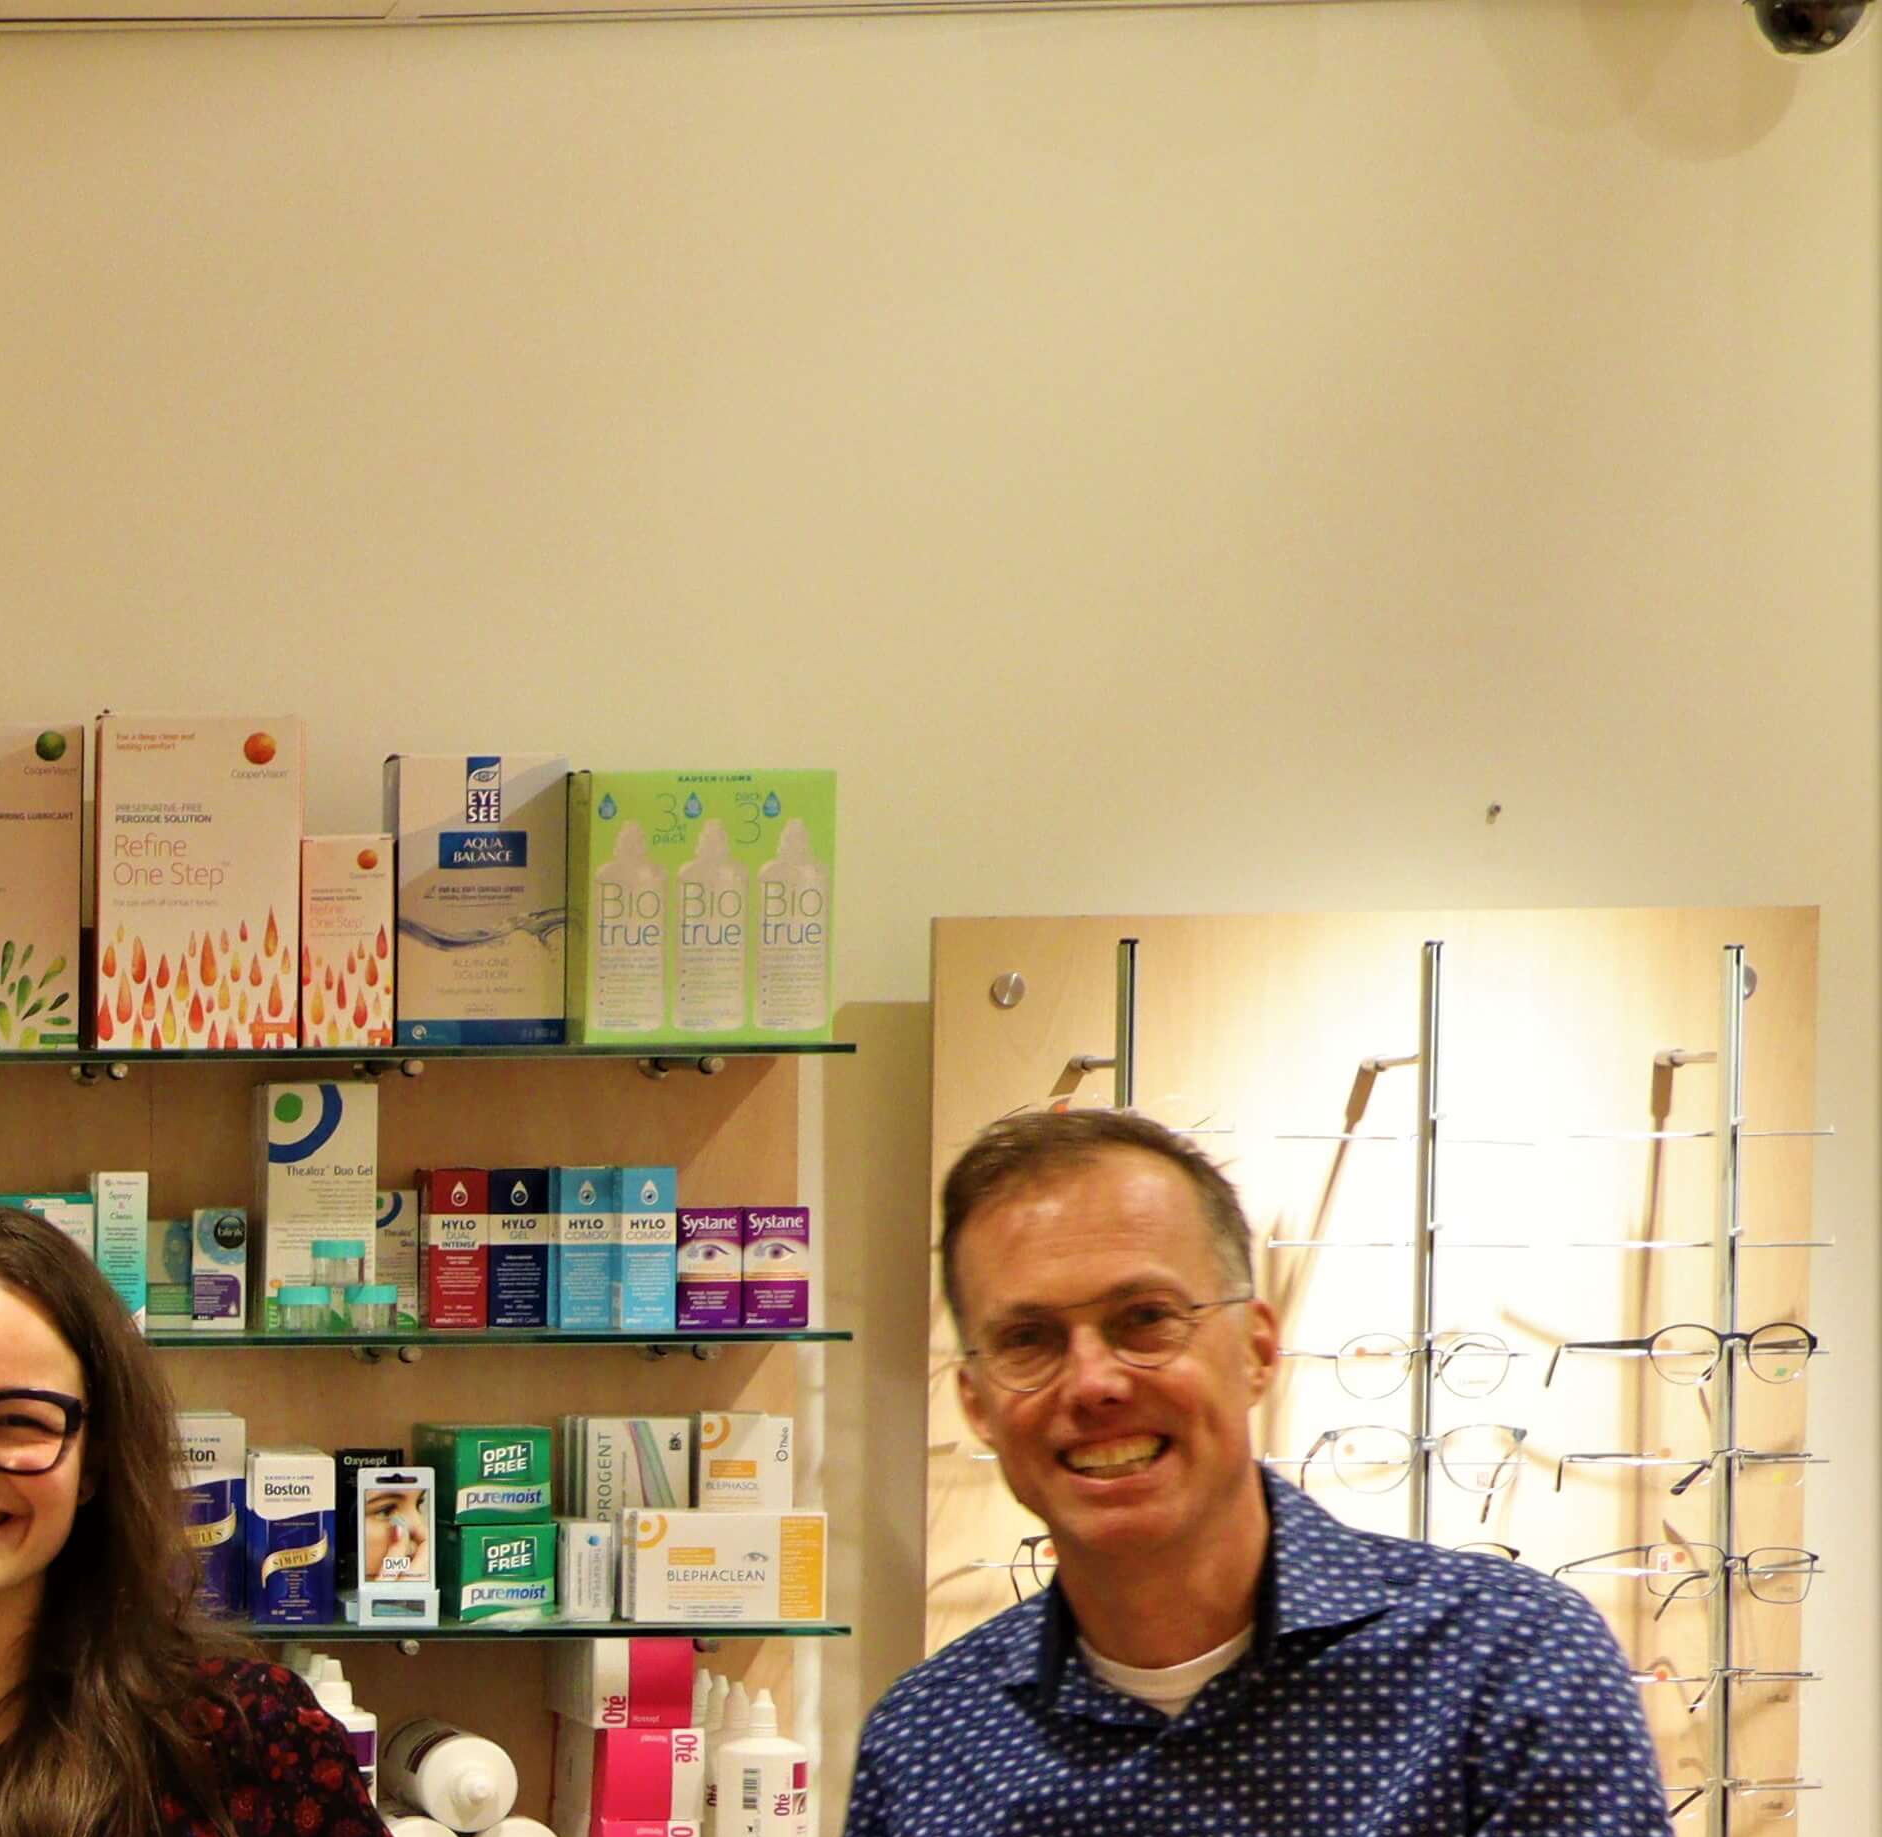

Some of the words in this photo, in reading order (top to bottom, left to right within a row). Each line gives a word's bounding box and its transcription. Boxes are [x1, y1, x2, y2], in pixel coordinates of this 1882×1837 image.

[468, 790, 499, 806] EYE
[116, 815, 162, 824] PEROXIDE
[164, 814, 211, 823] SOLUTION
[468, 806, 499, 822] SEE
[736, 802, 761, 844] 3
[115, 833, 187, 858] Refine
[463, 838, 503, 849] AQUA
[653, 833, 685, 845] pack
[453, 851, 512, 863] BALANCE
[113, 862, 163, 886] One
[172, 862, 224, 890] Step
[600, 882, 661, 919] Bio
[682, 882, 741, 918] Bio
[764, 881, 823, 918] Bio
[598, 919, 660, 947] true
[681, 918, 741, 946] true
[763, 917, 822, 946] true
[287, 1166, 325, 1177] Thealoz
[334, 1166, 354, 1176] Duo
[357, 1165, 373, 1176] Gel
[442, 1220, 476, 1230] HYLO
[502, 1219, 537, 1229] HYLO
[569, 1219, 604, 1229] HYLO
[630, 1218, 665, 1229] HYLO
[683, 1214, 737, 1237] Systane
[748, 1213, 804, 1236] Systane
[509, 1231, 529, 1239] GEL
[343, 1455, 387, 1467] Oxysept
[482, 1444, 527, 1462] OPTI-
[483, 1458, 528, 1478] FREE
[597, 1432, 612, 1523] PROGENT
[265, 1483, 310, 1496] Boston
[706, 1481, 759, 1491] BLEPHASOL
[466, 1488, 542, 1508] puremoist
[487, 1540, 530, 1558] OPTI-
[386, 1558, 409, 1570] DMV
[487, 1554, 531, 1574] FREE
[667, 1570, 765, 1582] BLEPHACLEAN
[471, 1584, 546, 1604] puremoist
[602, 1695, 626, 1725] Oté
[675, 1734, 699, 1763] Oté
[774, 1793, 790, 1817] Oté
